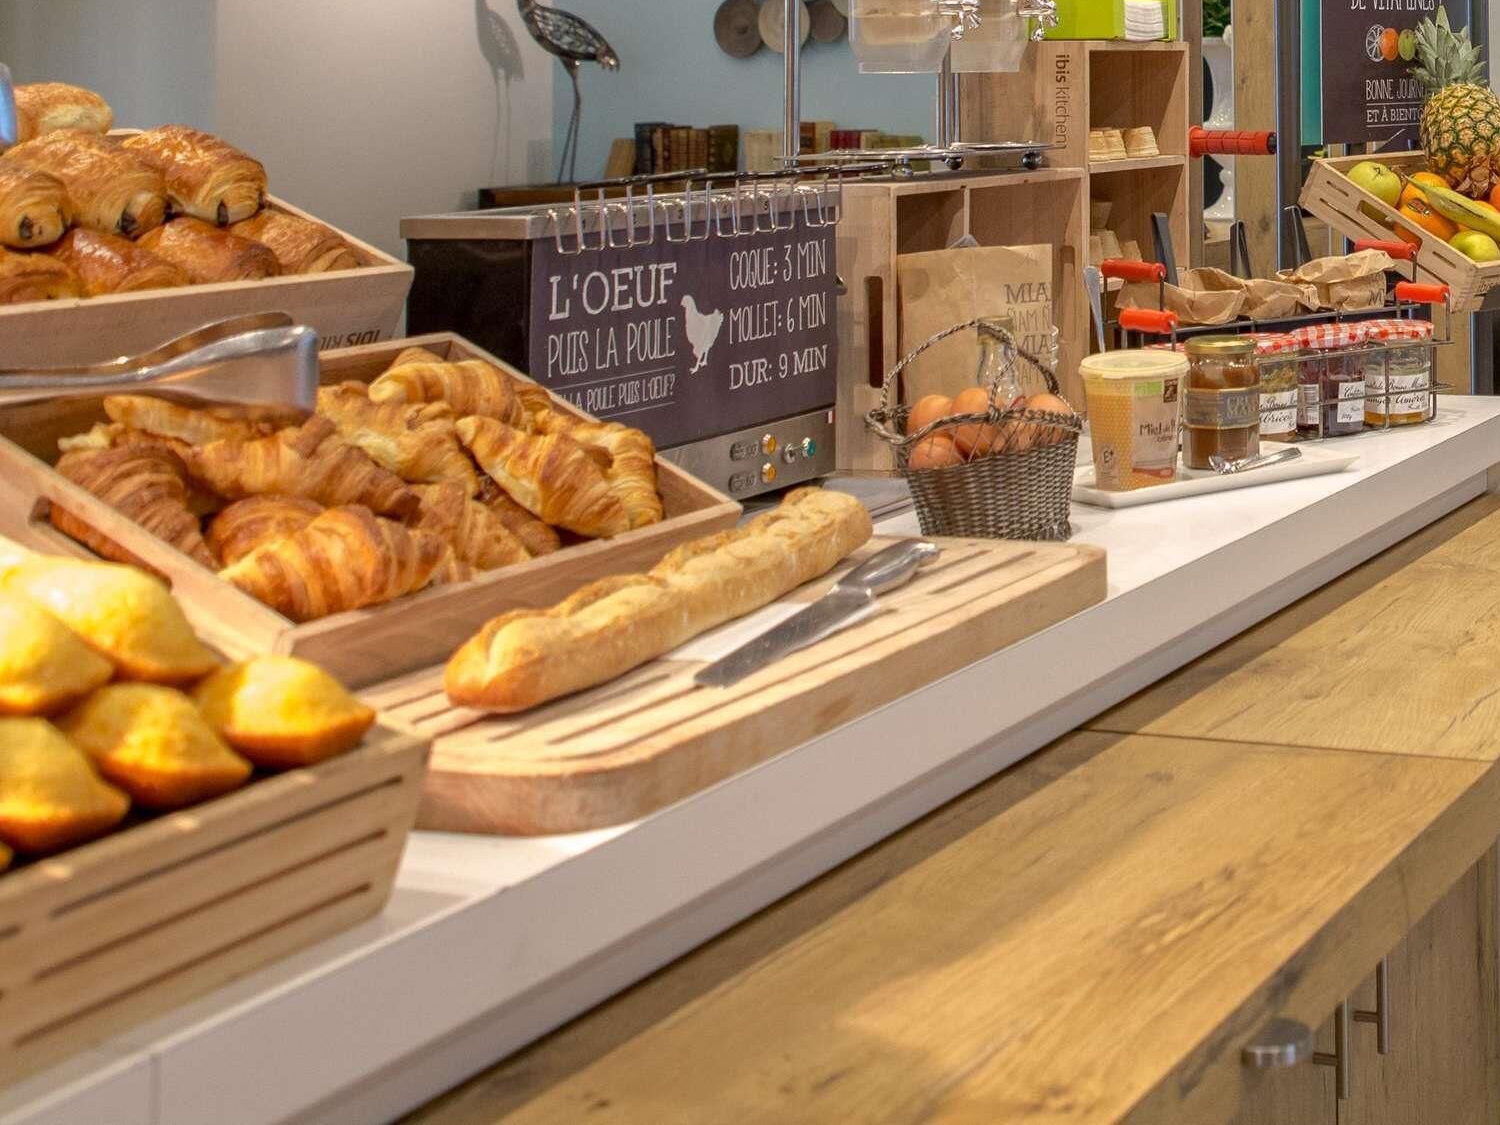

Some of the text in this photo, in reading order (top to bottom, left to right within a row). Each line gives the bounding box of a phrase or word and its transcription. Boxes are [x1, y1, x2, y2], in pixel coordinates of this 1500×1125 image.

[1055, 54, 1071, 83] ibis
[1365, 79, 1394, 101] BONNE
[1366, 109, 1379, 123] ET
[729, 239, 827, 291] COQUE: 3 MIN
[548, 262, 678, 321] L'OEUF
[728, 291, 827, 345] MOLLET: 6 MIN
[547, 316, 676, 378] PUIS LA POULE
[729, 344, 828, 390] DUR: 9 MIN
[586, 384, 616, 413] POULE
[618, 379, 640, 406] PUIS
